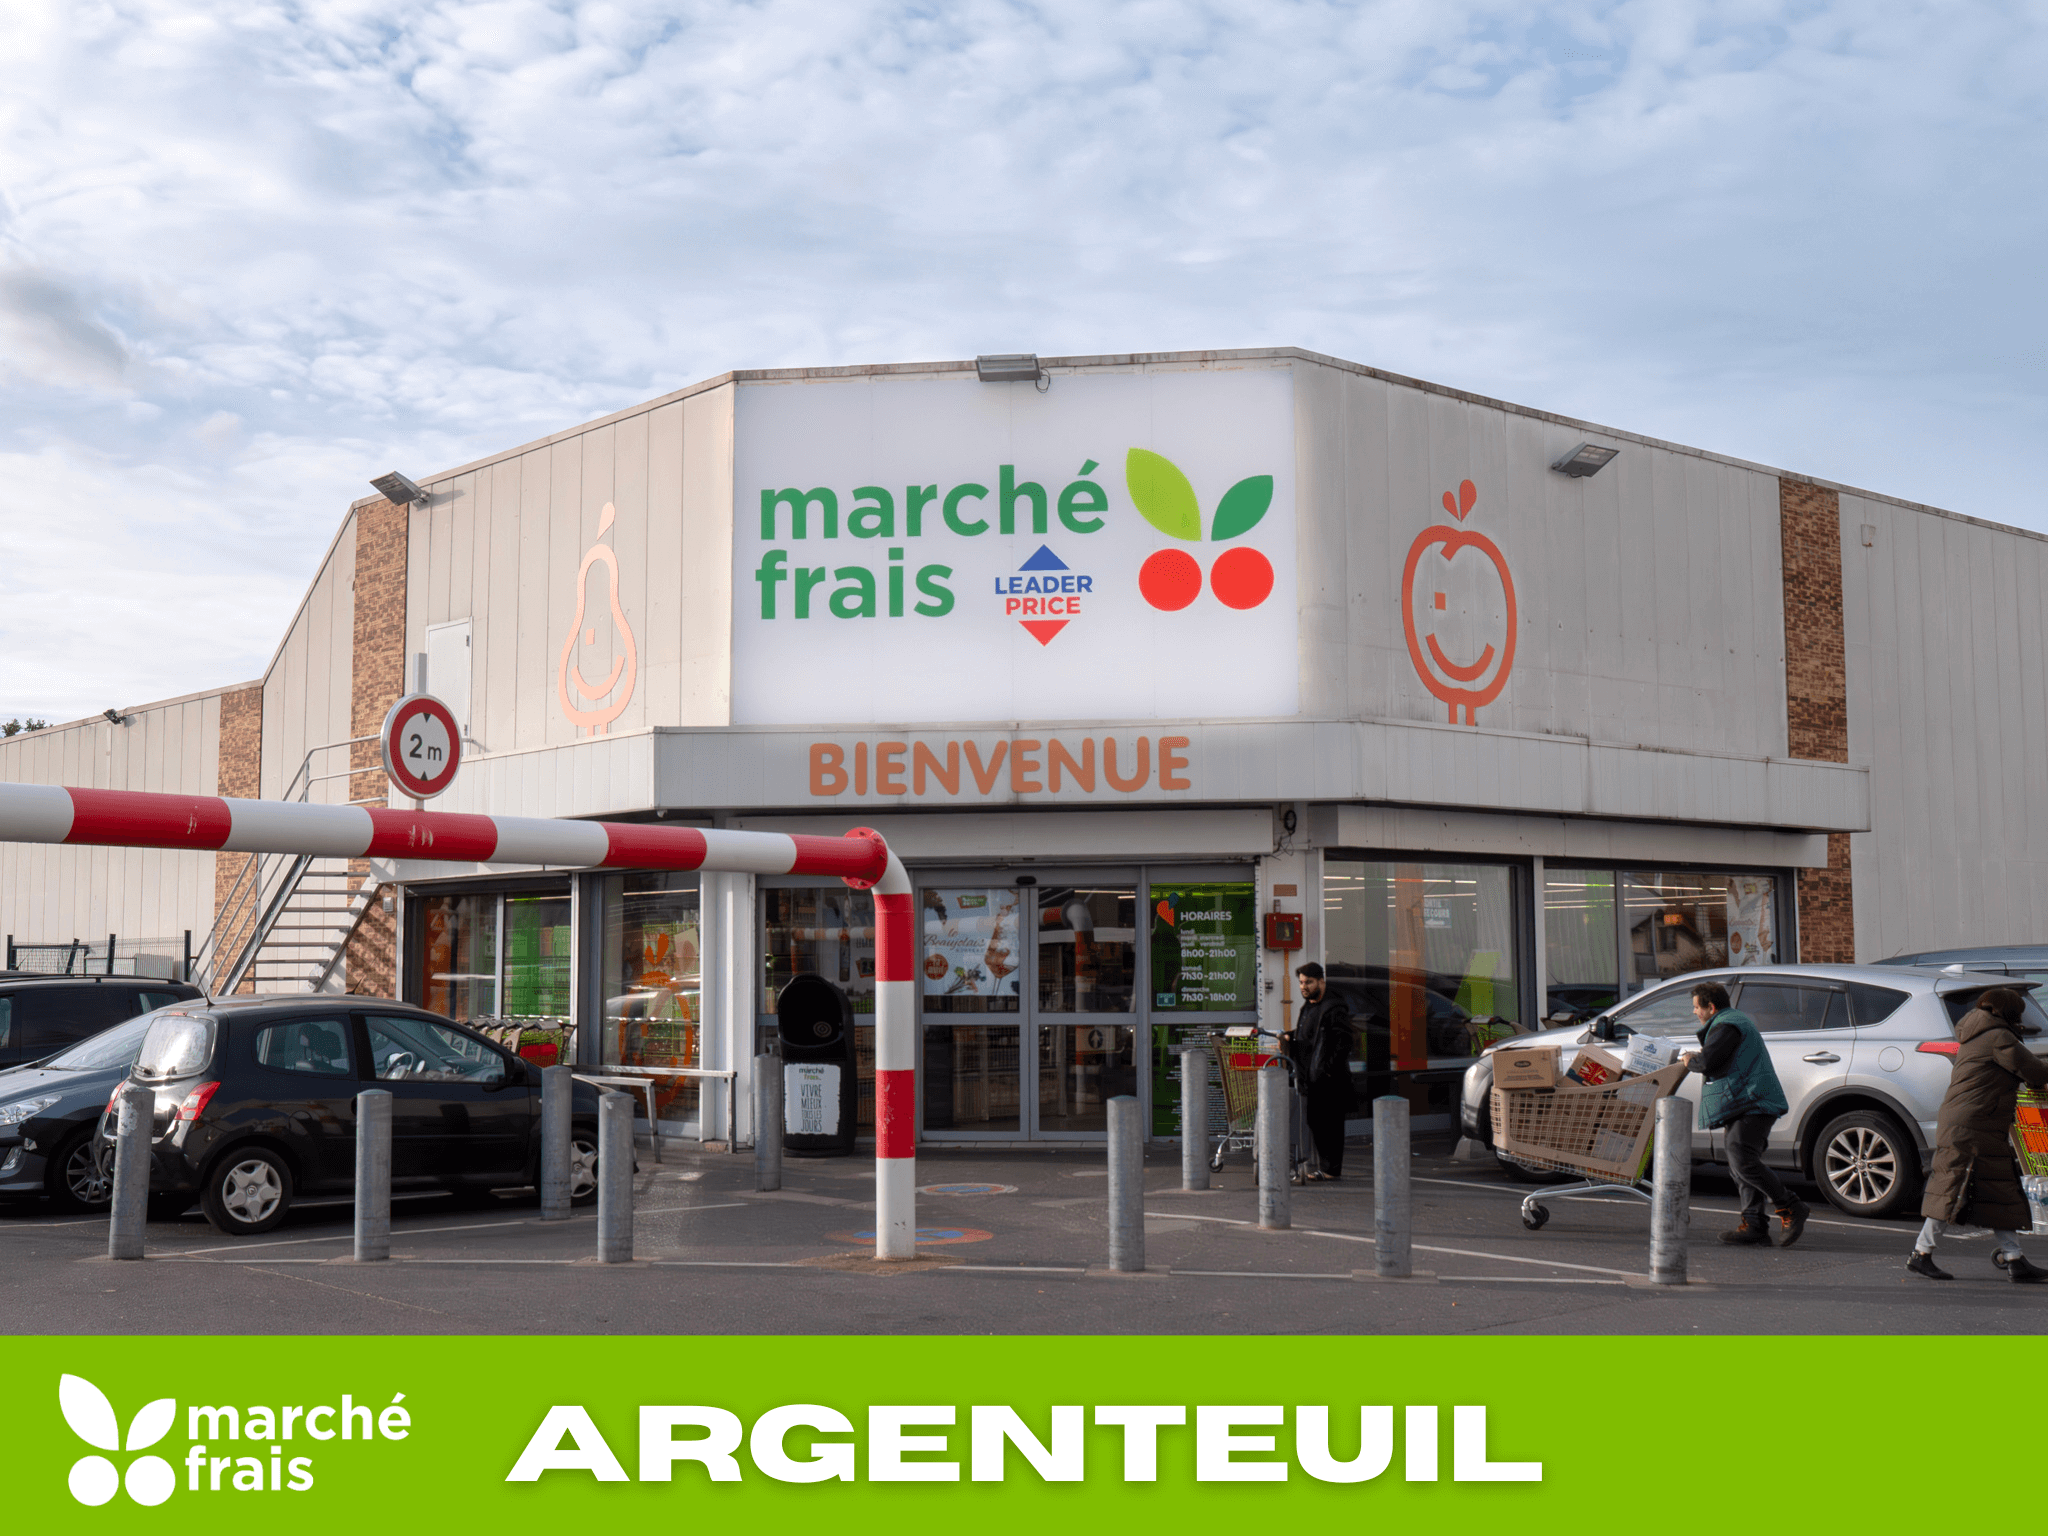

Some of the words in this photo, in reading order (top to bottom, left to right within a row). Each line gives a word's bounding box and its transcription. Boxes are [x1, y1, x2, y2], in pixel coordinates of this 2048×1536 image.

[762, 459, 1108, 540] marché
[755, 547, 955, 620] frais
[995, 575, 1093, 595] LEADER
[1005, 597, 1081, 616] PRICE
[409, 733, 423, 759] 2
[427, 745, 443, 761] m
[809, 735, 1191, 796] BIENVENUE
[1180, 911, 1232, 921] HORAIRES
[801, 1084, 822, 1097] VIVRE
[801, 1098, 822, 1110] MIEUX
[801, 1119, 822, 1132] JOURS
